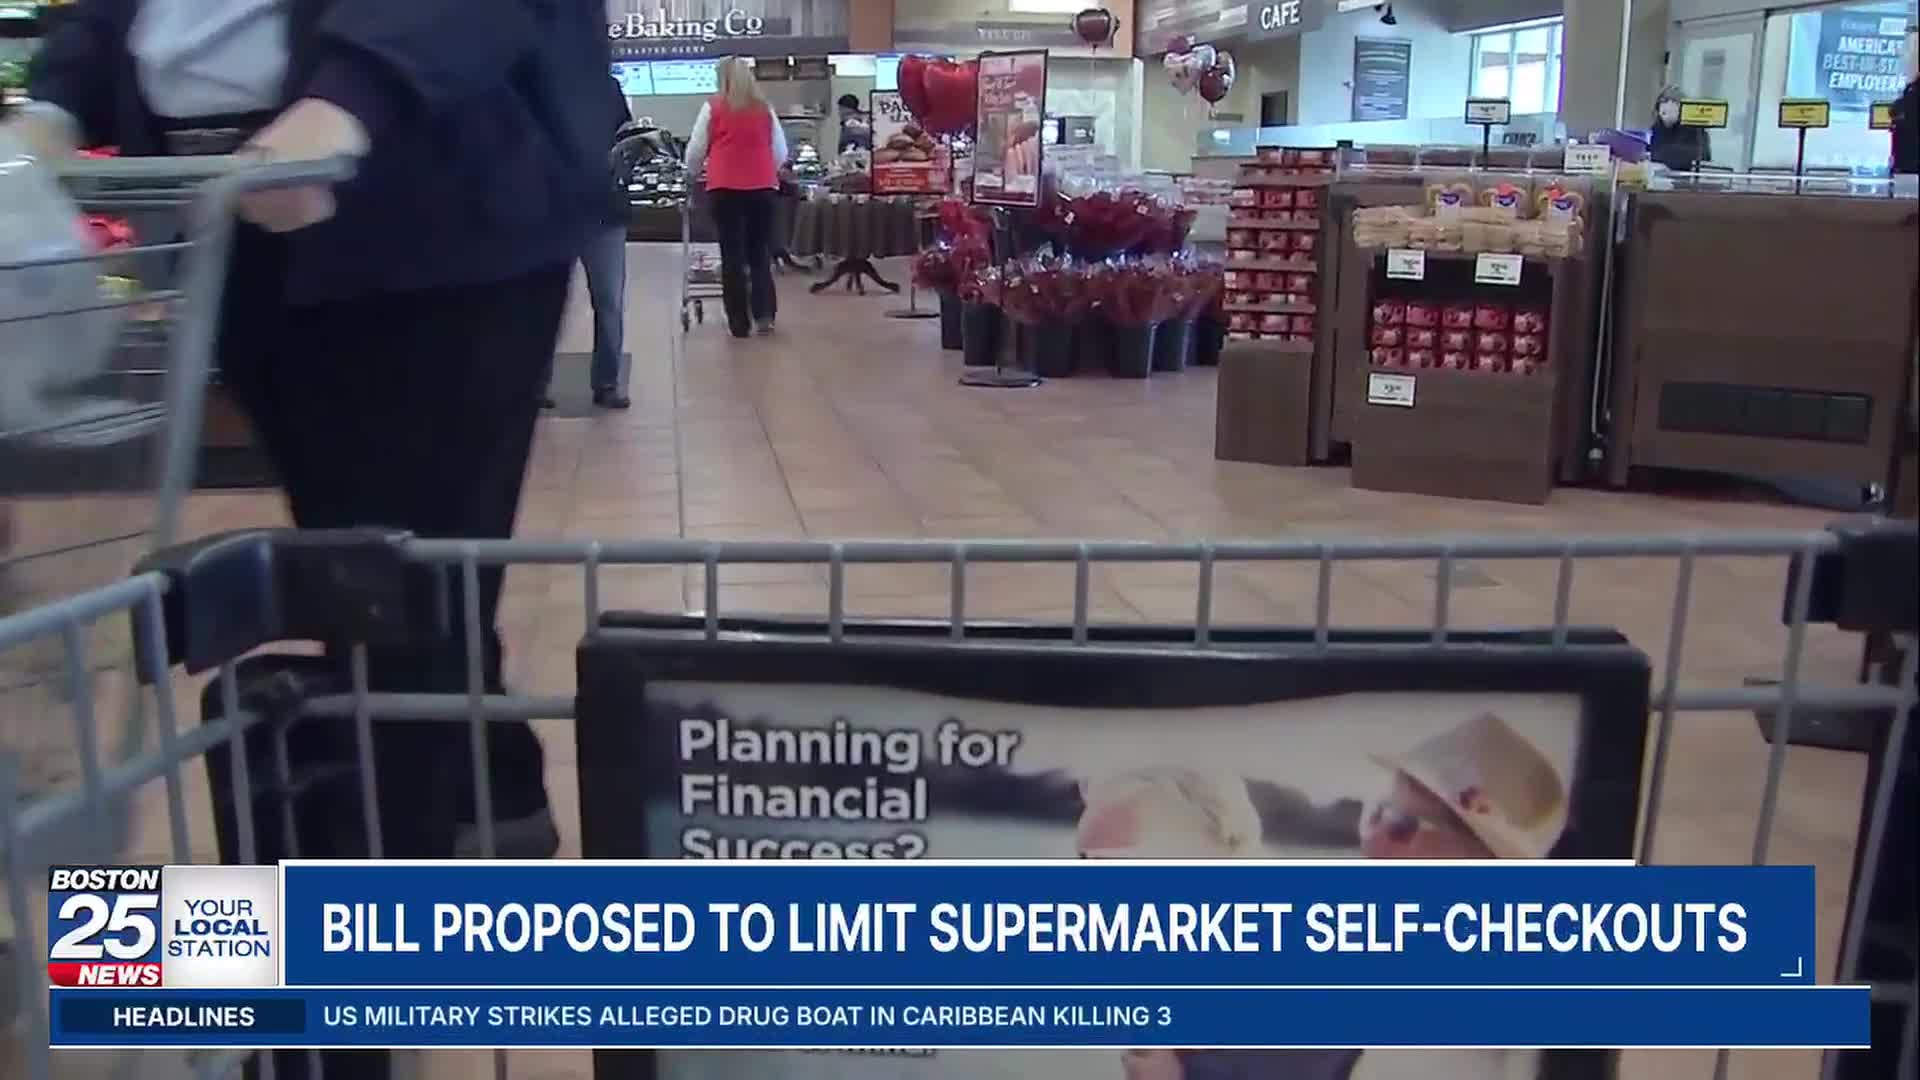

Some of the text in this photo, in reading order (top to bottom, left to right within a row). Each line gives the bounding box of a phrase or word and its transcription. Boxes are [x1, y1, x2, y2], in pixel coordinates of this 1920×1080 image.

[625, 8, 718, 42] Baking
[724, 8, 763, 35] Co
[1260, 1, 1300, 30] CAFE
[680, 719, 1021, 773] Planning for
[681, 773, 928, 821] Financial
[682, 828, 926, 859] Success?
